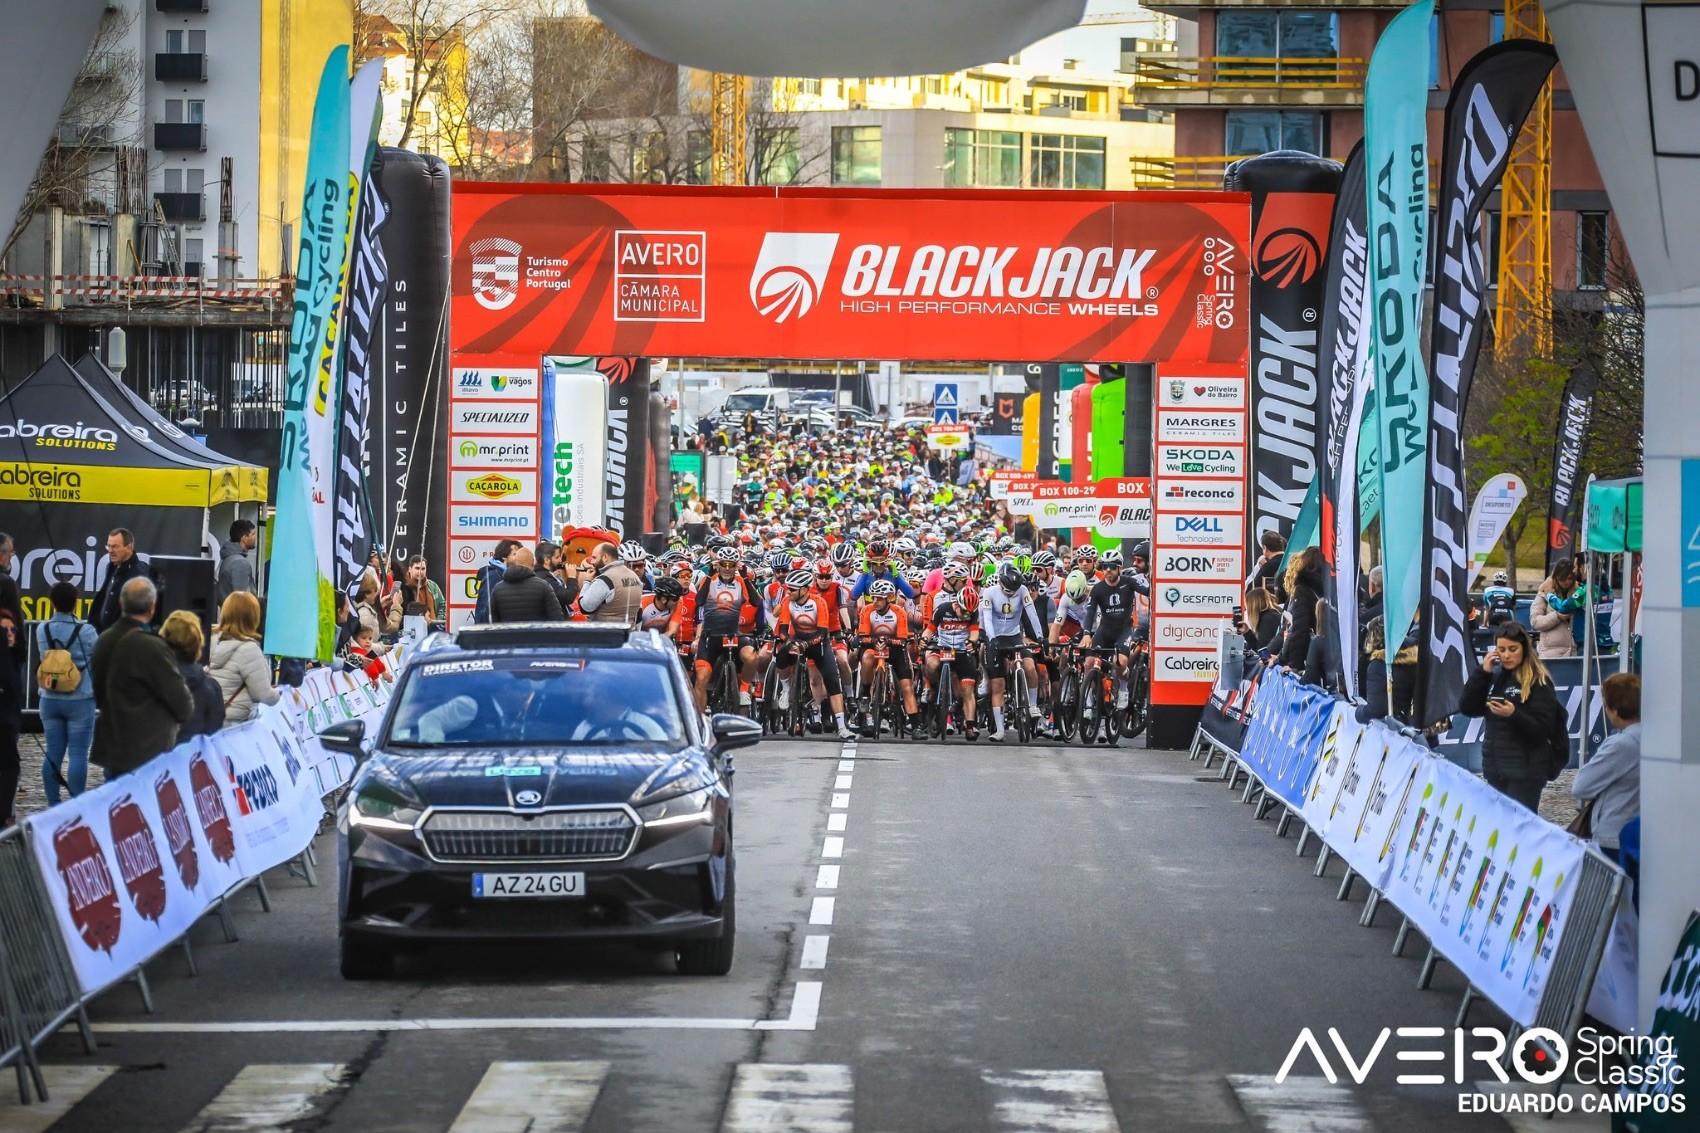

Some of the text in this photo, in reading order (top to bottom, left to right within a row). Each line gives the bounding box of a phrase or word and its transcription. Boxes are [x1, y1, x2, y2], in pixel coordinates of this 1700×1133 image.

[621, 243, 699, 266] AVEIRO
[526, 256, 568, 267] Turismo
[526, 268, 561, 278] Centro
[841, 244, 1157, 300] BLACKJACK
[526, 279, 571, 289] Portugal
[621, 299, 699, 313] MUNICIPAL
[840, 301, 1159, 317] HIGH PERFORMANCE WHEELS
[396, 279, 408, 561] CERAMIC TILES
[460, 412, 529, 423] SPECIALIZED
[1166, 418, 1237, 427] MARGRES
[35, 438, 117, 451] SOLUTIONS
[1166, 463, 1235, 474] We Love Cycling
[0, 464, 81, 487] abreira
[469, 482, 519, 491] CACAROLA
[1040, 488, 1060, 496] BOX
[1117, 483, 1144, 494] BOX
[29, 487, 81, 500] SOLUTIONS
[1185, 490, 1235, 498] reconco
[459, 516, 529, 527] SHIMANO
[1176, 517, 1223, 532] DELL
[1176, 535, 1224, 543] Technologies
[1165, 557, 1215, 572] BORN
[424, 660, 494, 673] DIRETOR
[493, 875, 577, 894] AZ 24 GU
